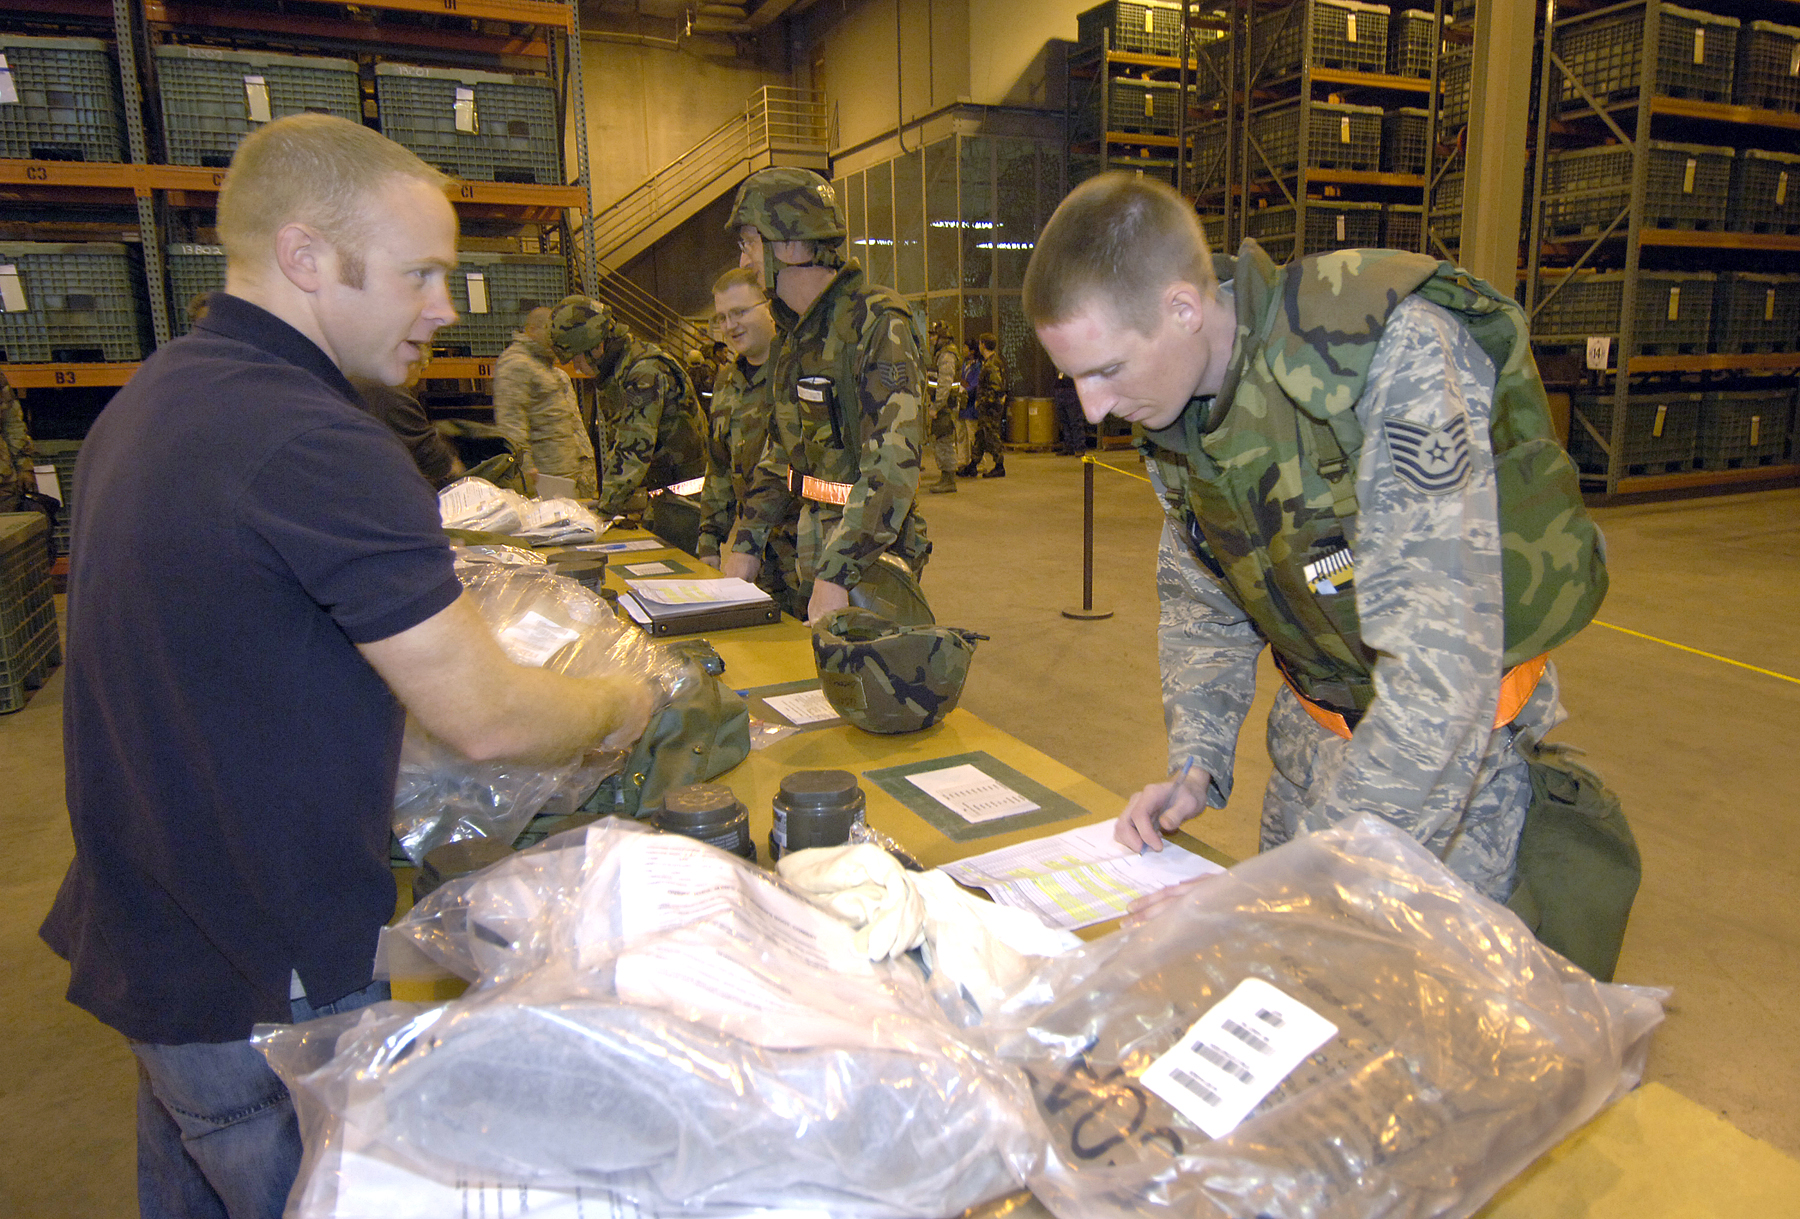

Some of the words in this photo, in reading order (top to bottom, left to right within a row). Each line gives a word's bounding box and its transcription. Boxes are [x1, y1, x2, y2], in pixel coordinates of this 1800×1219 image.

[26, 166, 48, 181] C3
[212, 172, 226, 187] C
[55, 371, 76, 385] B3
